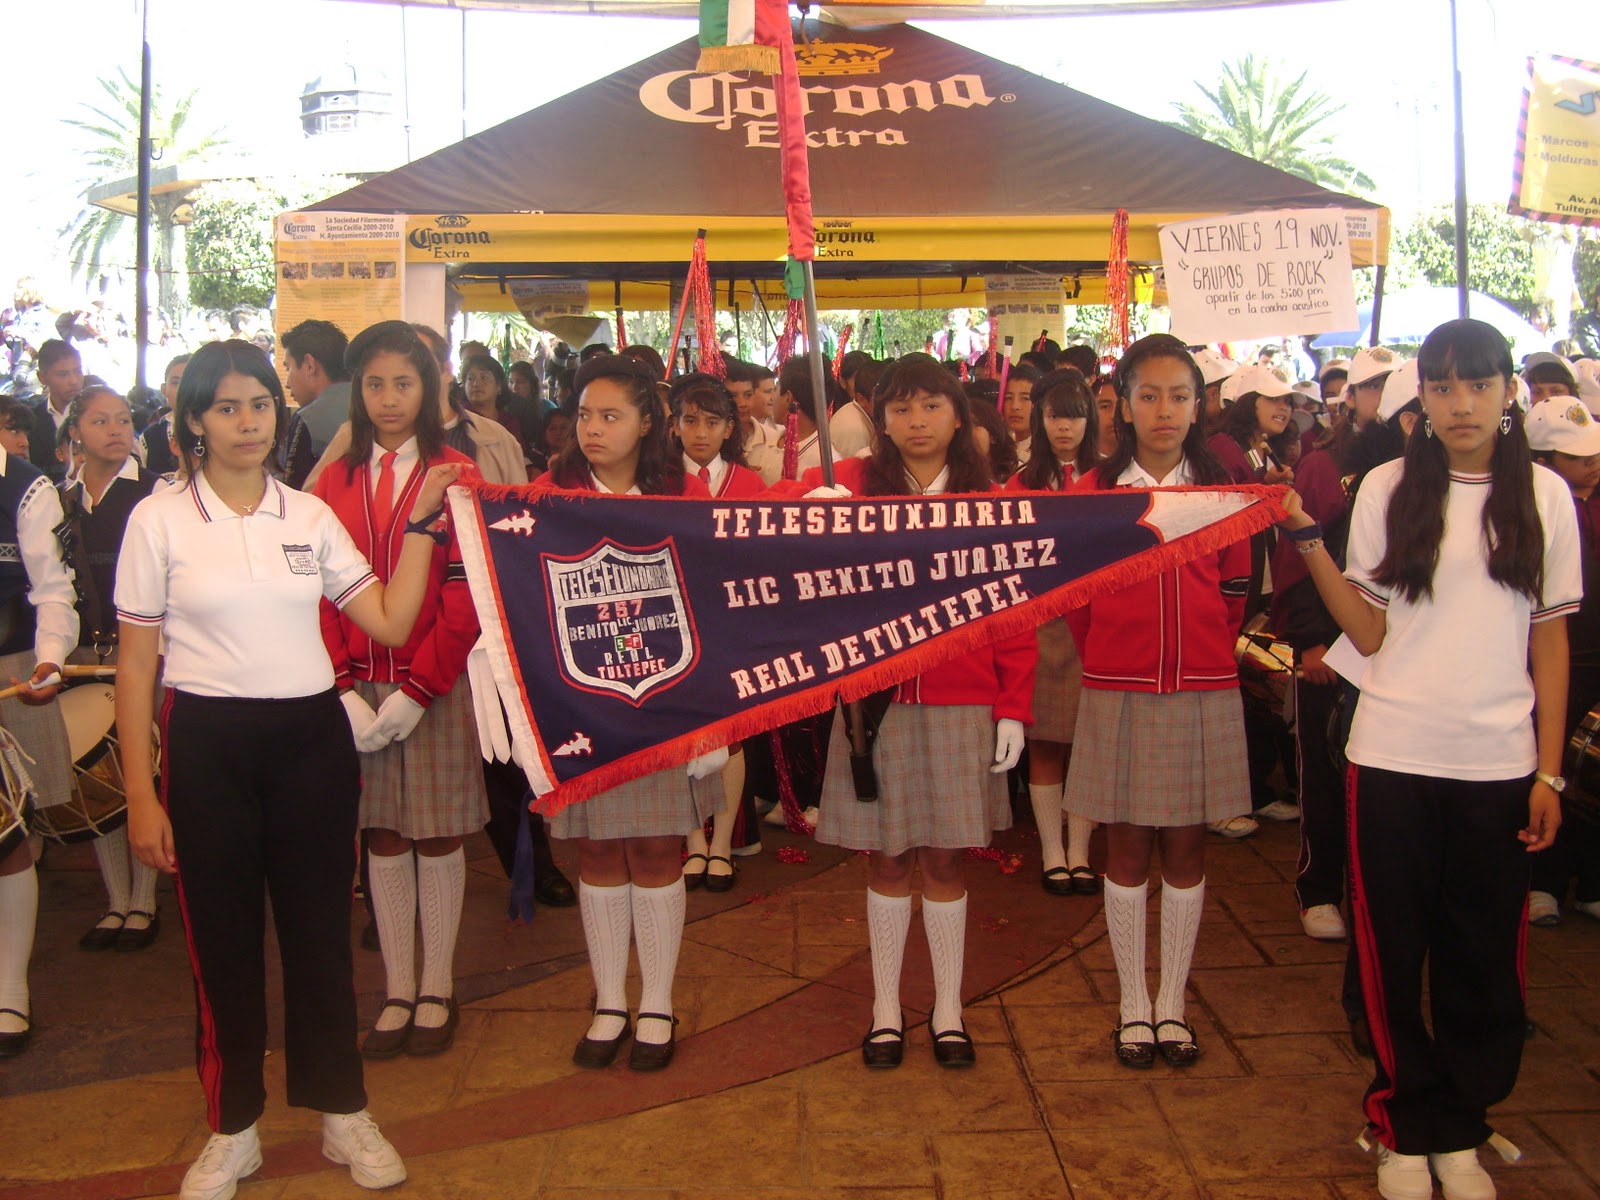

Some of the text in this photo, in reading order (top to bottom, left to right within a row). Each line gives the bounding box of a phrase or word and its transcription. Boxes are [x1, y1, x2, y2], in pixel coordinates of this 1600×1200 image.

[639, 70, 996, 131] Corona
[1542, 135, 1589, 148] Marcos
[1540, 152, 1598, 166] Molduras
[1569, 195, 1586, 204] Av.
[1555, 203, 1600, 215] Tultepe
[284, 222, 316, 235] Corona
[814, 227, 875, 243] orona
[1171, 218, 1343, 253] VIERNES 19 NOV.
[409, 228, 491, 251] Corona
[434, 247, 470, 259] Extra
[818, 246, 854, 257] Extra
[1257, 262, 1276, 288] DE
[1246, 291, 1257, 300] de
[1261, 291, 1275, 300] las
[1281, 288, 1304, 299] 5:00
[1307, 288, 1323, 300] pm
[1228, 307, 1241, 315] en
[1247, 303, 1257, 313] la
[712, 500, 1037, 538] TELESECUNDARIA
[723, 538, 1057, 608] LIC BENITO JUAREZ
[569, 621, 620, 642] BENITO
[598, 659, 667, 680] TULTEPEC
[730, 651, 816, 700] REAL
